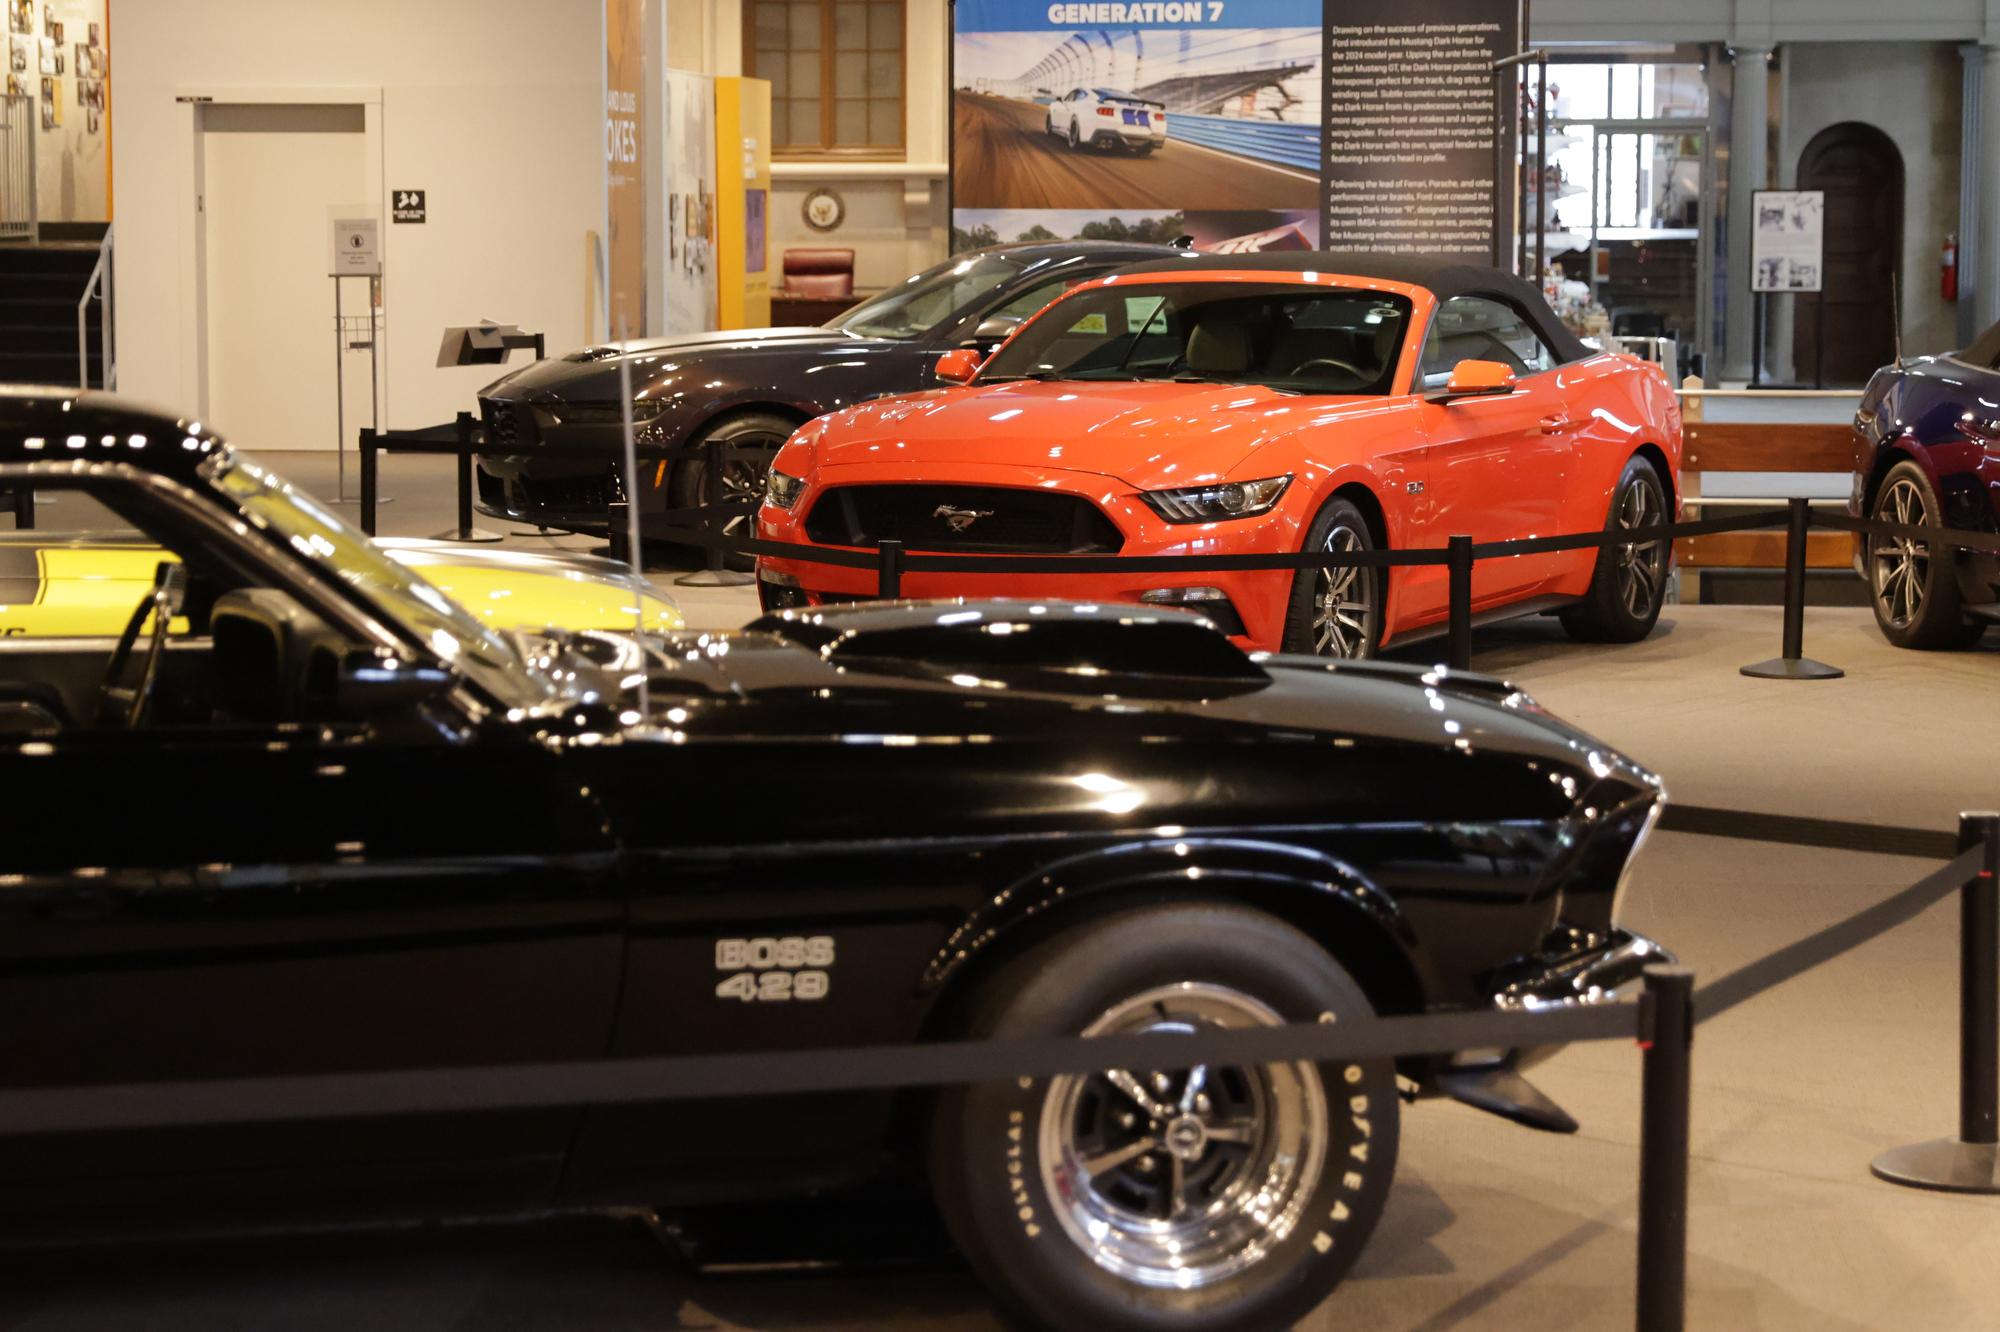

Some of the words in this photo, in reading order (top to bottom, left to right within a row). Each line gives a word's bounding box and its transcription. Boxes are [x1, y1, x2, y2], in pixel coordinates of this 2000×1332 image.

[1047, 2, 1203, 24] GENERATION
[1207, 1, 1224, 22] 7
[715, 936, 835, 970] BOSS
[715, 970, 829, 1002] 429
